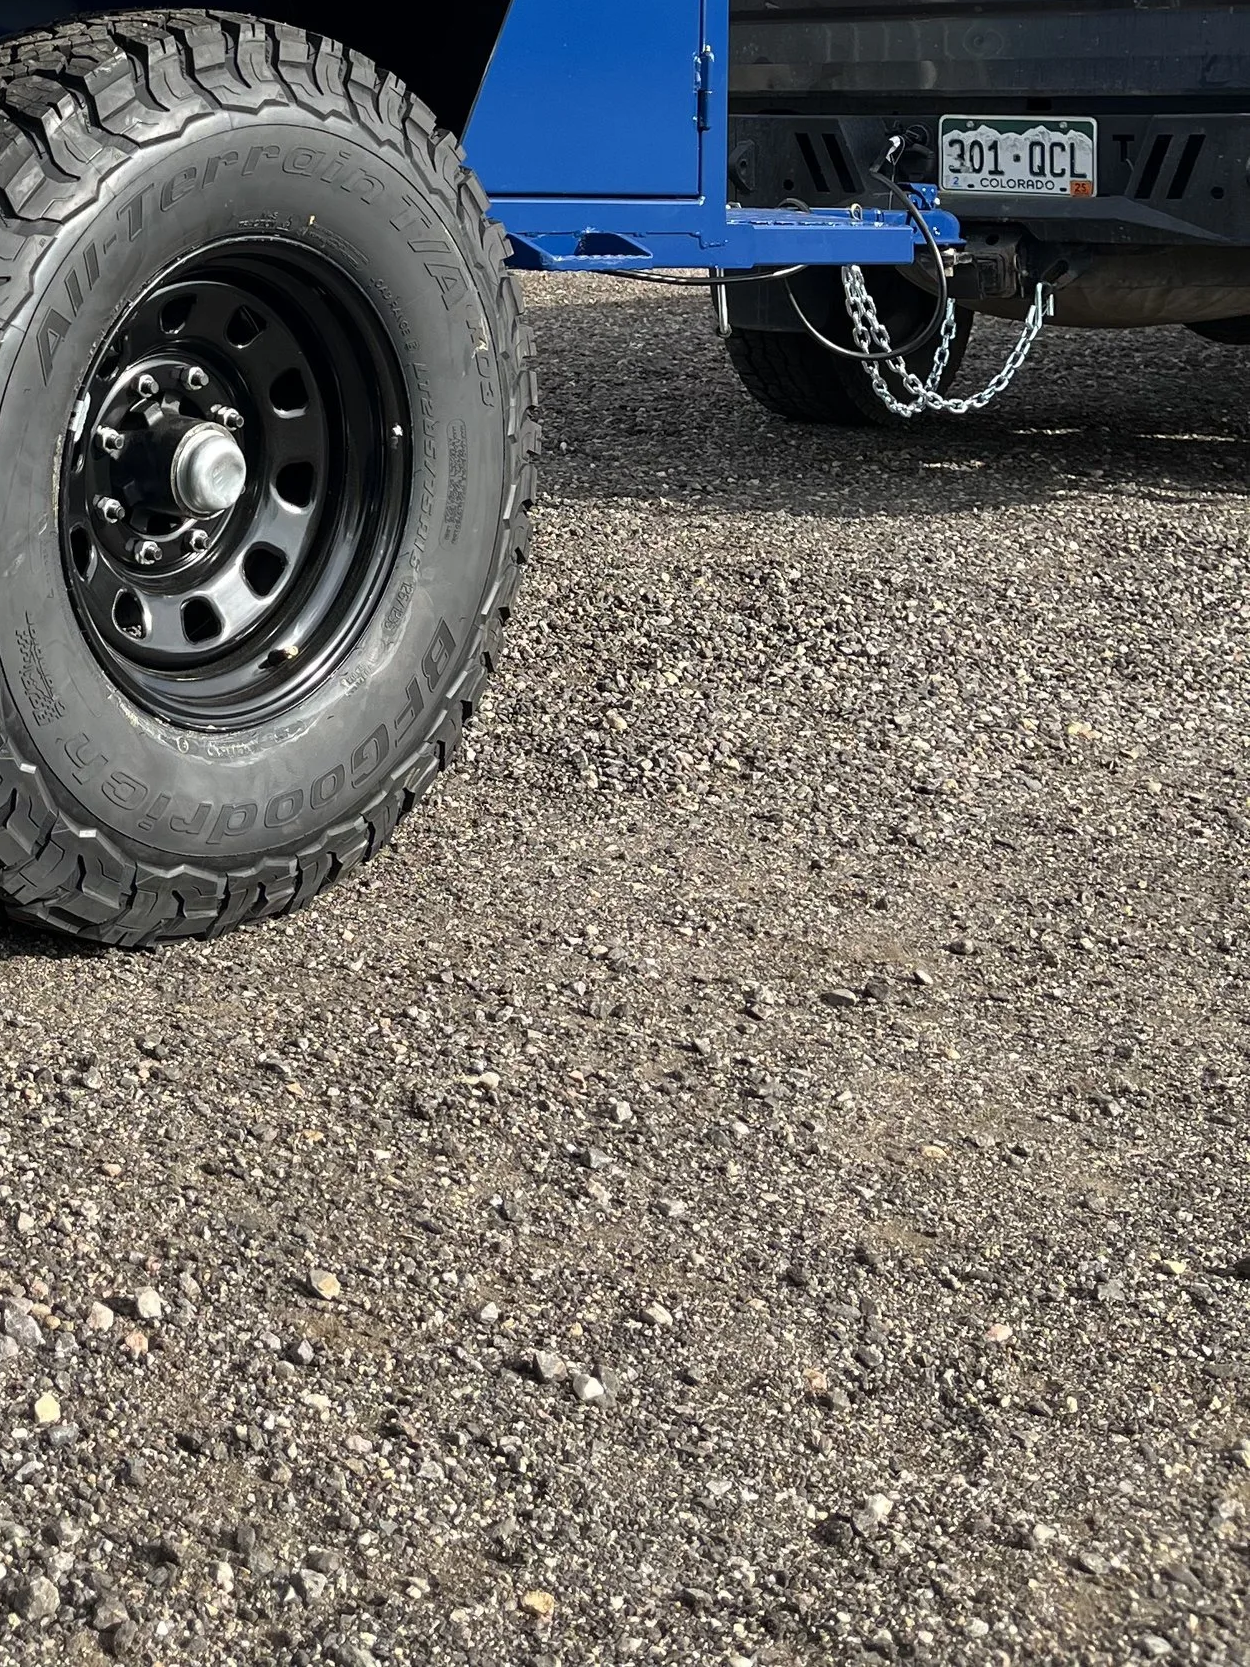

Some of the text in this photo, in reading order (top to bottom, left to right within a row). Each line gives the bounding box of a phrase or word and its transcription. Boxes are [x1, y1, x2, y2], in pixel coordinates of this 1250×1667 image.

[948, 138, 1088, 179] 301 QCL
[979, 177, 1056, 191] COLORADO
[1073, 182, 1088, 193] 25
[36, 143, 385, 386] All-Terrain
[389, 195, 469, 312] T/A
[60, 616, 457, 846] BFGoodrich
